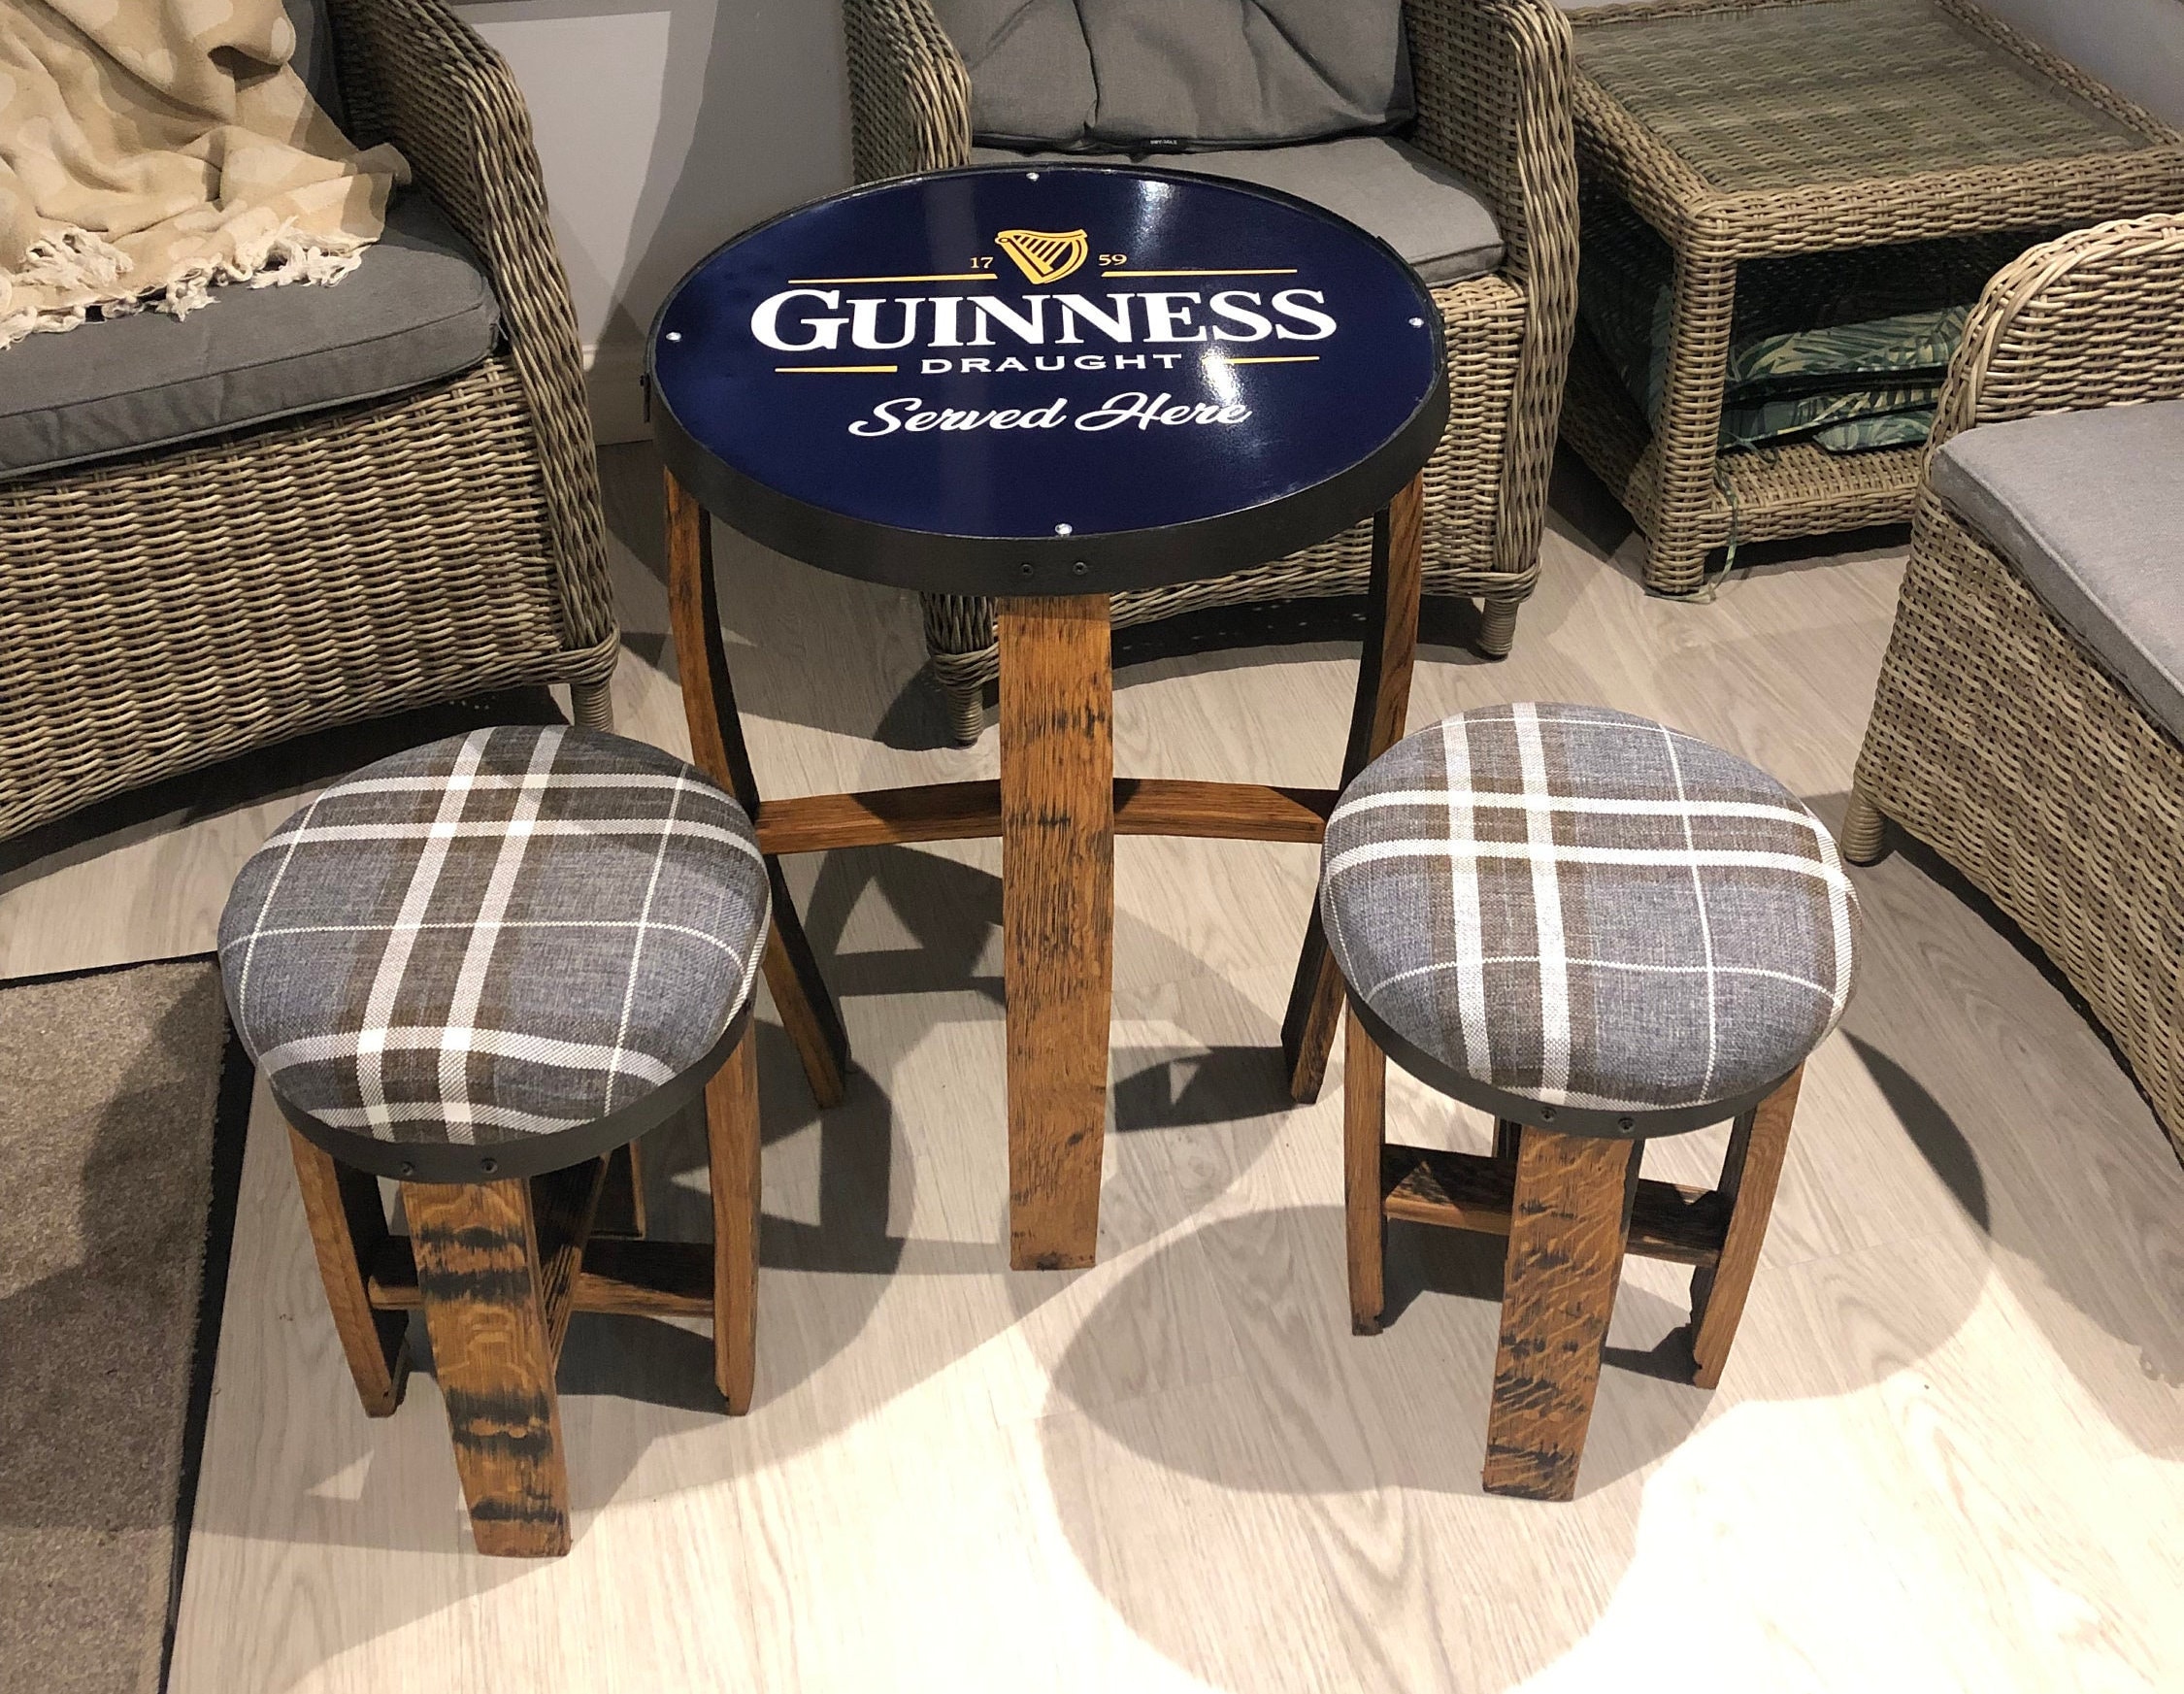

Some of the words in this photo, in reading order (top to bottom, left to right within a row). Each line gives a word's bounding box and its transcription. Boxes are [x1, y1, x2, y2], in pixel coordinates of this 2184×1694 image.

[970, 256, 994, 269] 17
[1099, 253, 1128, 266] 59
[750, 288, 1338, 351] GUINNESS
[920, 353, 1182, 374] DRAUGHT
[847, 397, 1068, 437] Served
[1075, 391, 1253, 432] Here
